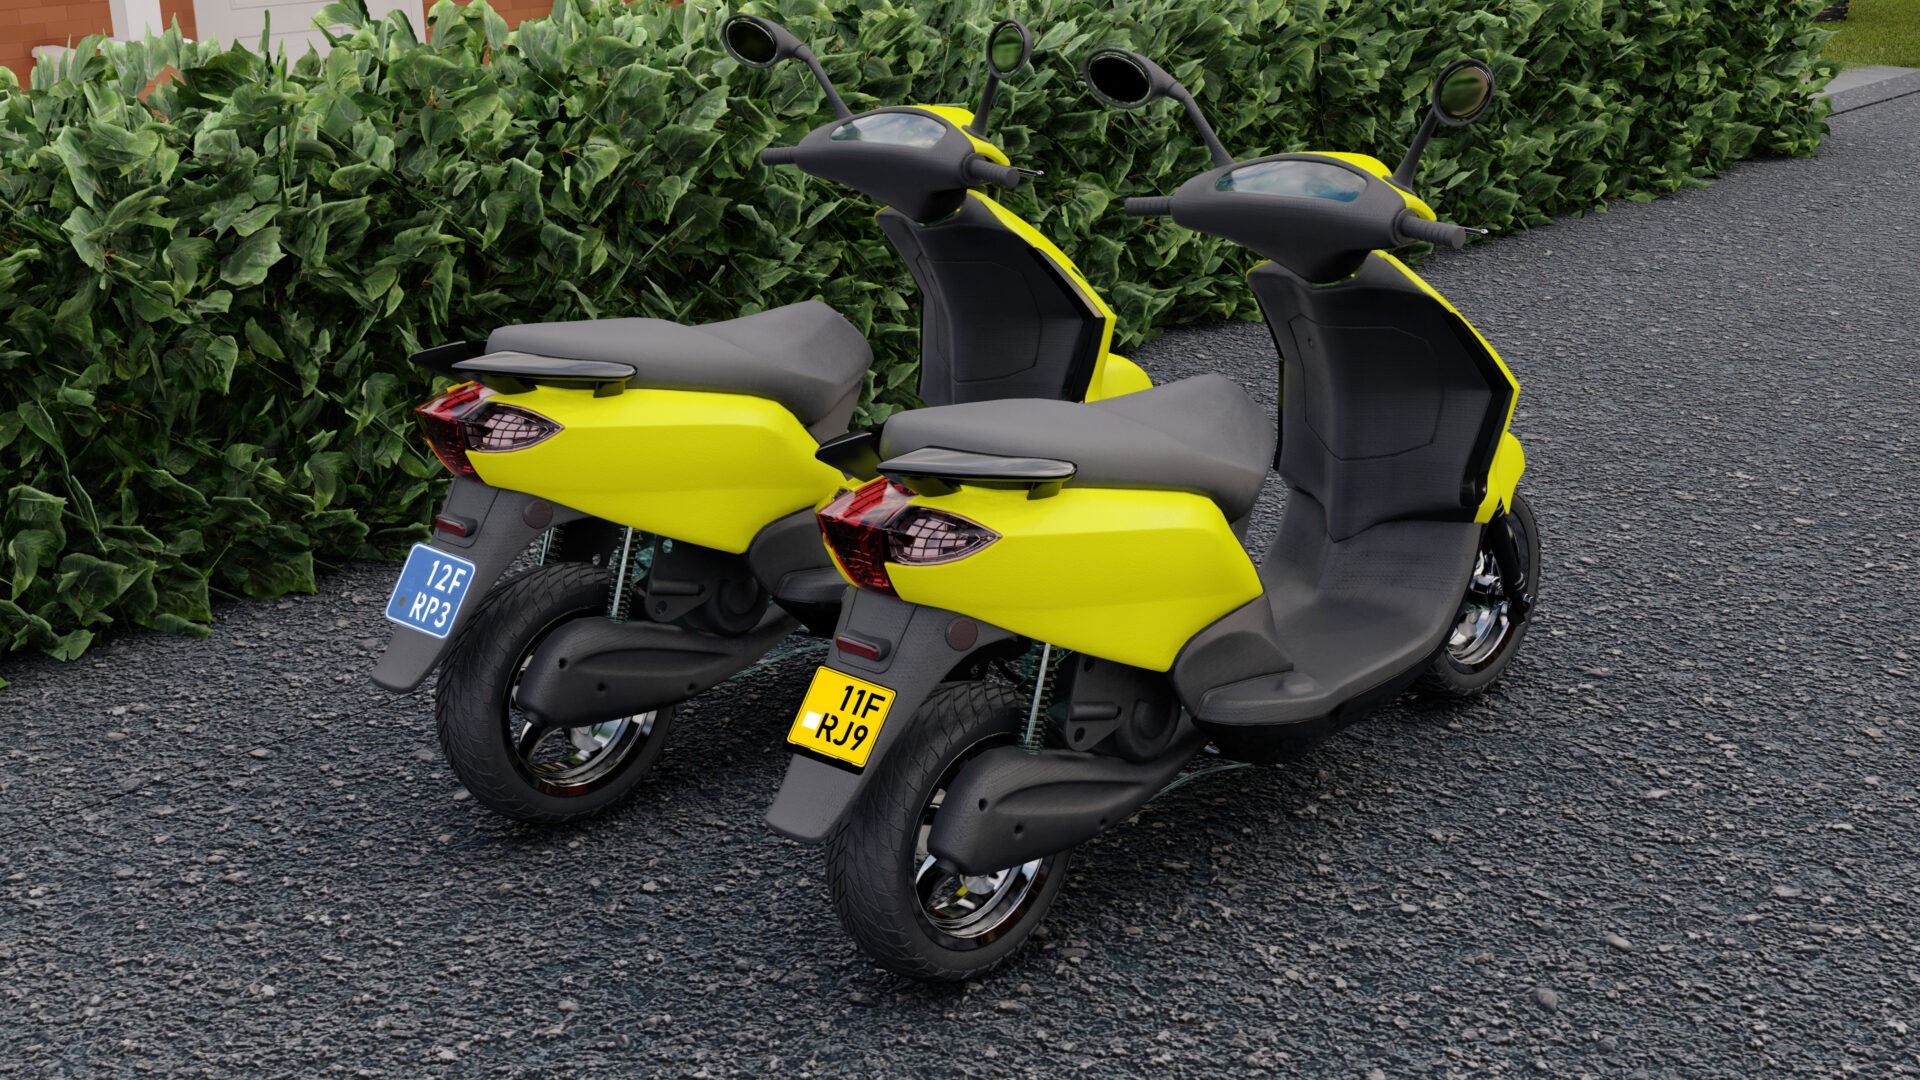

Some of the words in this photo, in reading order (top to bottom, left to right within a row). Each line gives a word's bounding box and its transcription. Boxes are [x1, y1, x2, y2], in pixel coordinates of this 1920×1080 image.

[426, 560, 467, 594] 12F
[408, 591, 451, 628] RP3
[840, 685, 886, 718] 11F
[815, 712, 869, 751] RJ9
